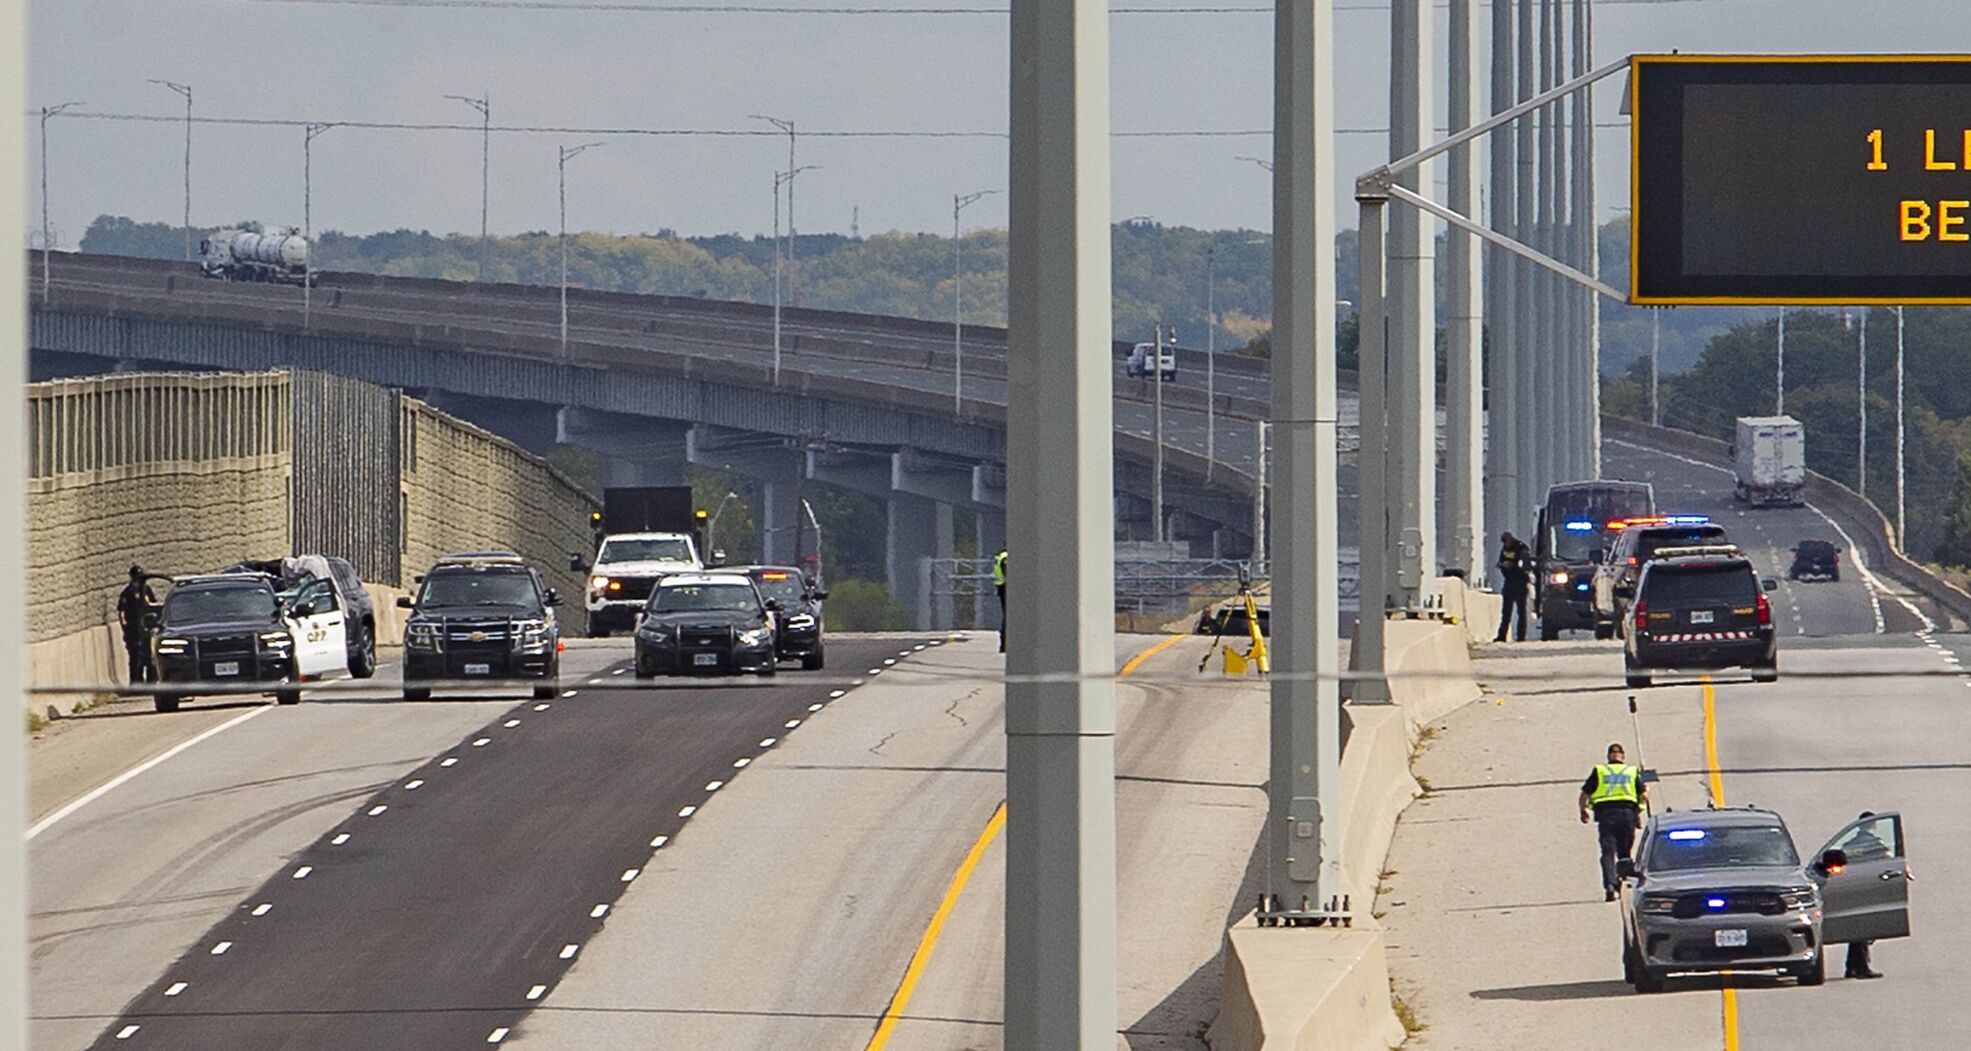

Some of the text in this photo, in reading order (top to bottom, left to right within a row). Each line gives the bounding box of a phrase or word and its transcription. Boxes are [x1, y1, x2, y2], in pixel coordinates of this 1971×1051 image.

[1867, 129, 1971, 170] 1 L
[1900, 200, 1970, 241] BE
